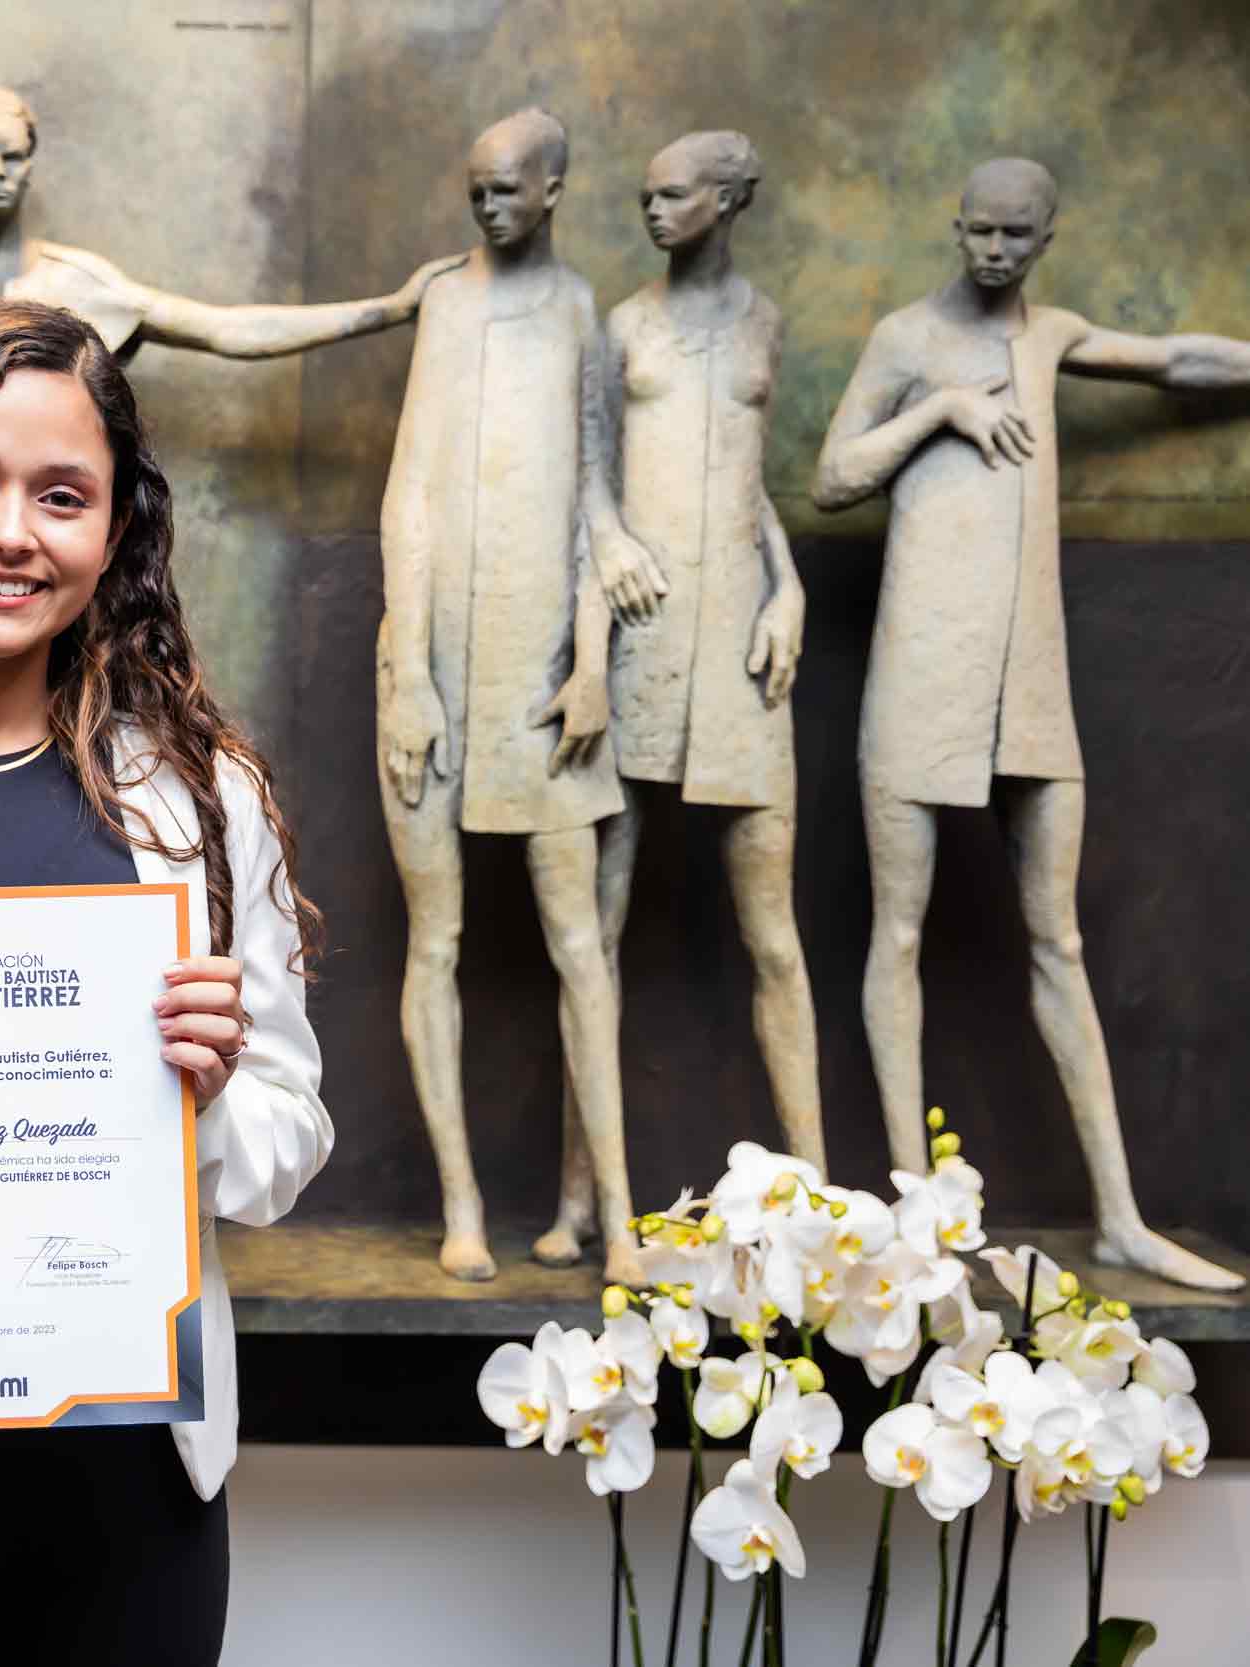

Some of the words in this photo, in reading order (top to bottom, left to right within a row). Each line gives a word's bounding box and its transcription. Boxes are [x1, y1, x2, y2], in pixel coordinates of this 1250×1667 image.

[4, 969, 80, 985] BAUTISTA
[44, 1049, 112, 1063] Gutiérrez,
[99, 1068, 113, 1079] a:
[13, 1116, 98, 1146] Quezada
[36, 1154, 52, 1165] ha
[78, 1153, 120, 1166] elegida
[0, 1170, 54, 1183] GUTIÉRREZ
[56, 1171, 71, 1181] DE
[73, 1170, 111, 1181] BOSCH
[47, 1261, 77, 1271] Felipe
[79, 1260, 108, 1270] Bosch
[16, 1325, 30, 1335] de
[32, 1324, 56, 1335] 2023
